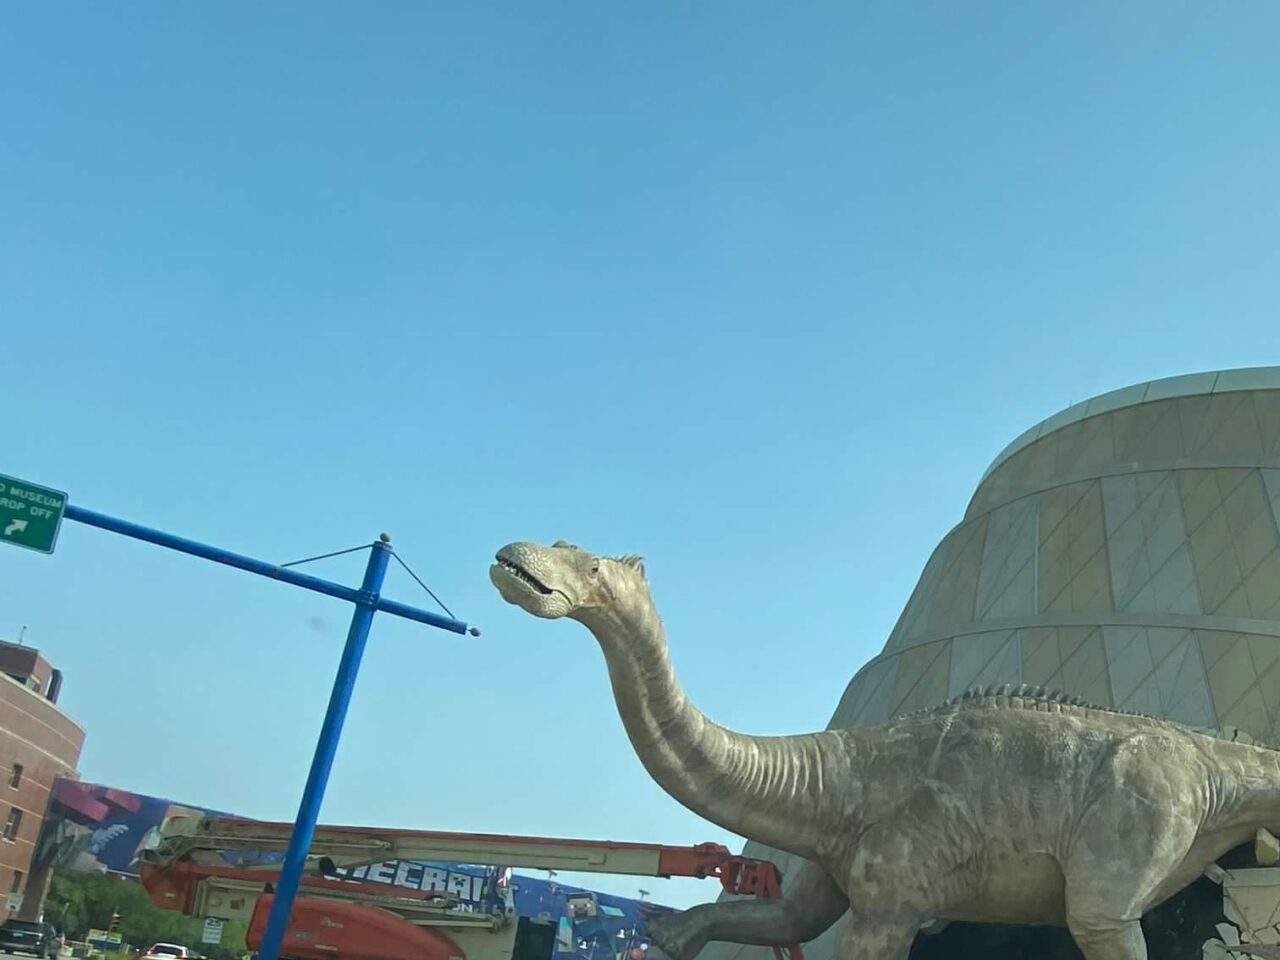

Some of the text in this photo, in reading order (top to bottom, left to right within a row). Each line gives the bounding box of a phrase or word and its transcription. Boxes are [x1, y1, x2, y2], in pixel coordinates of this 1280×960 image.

[0, 497, 54, 519] ROP OFF
[10, 487, 62, 508] MUSEUM
